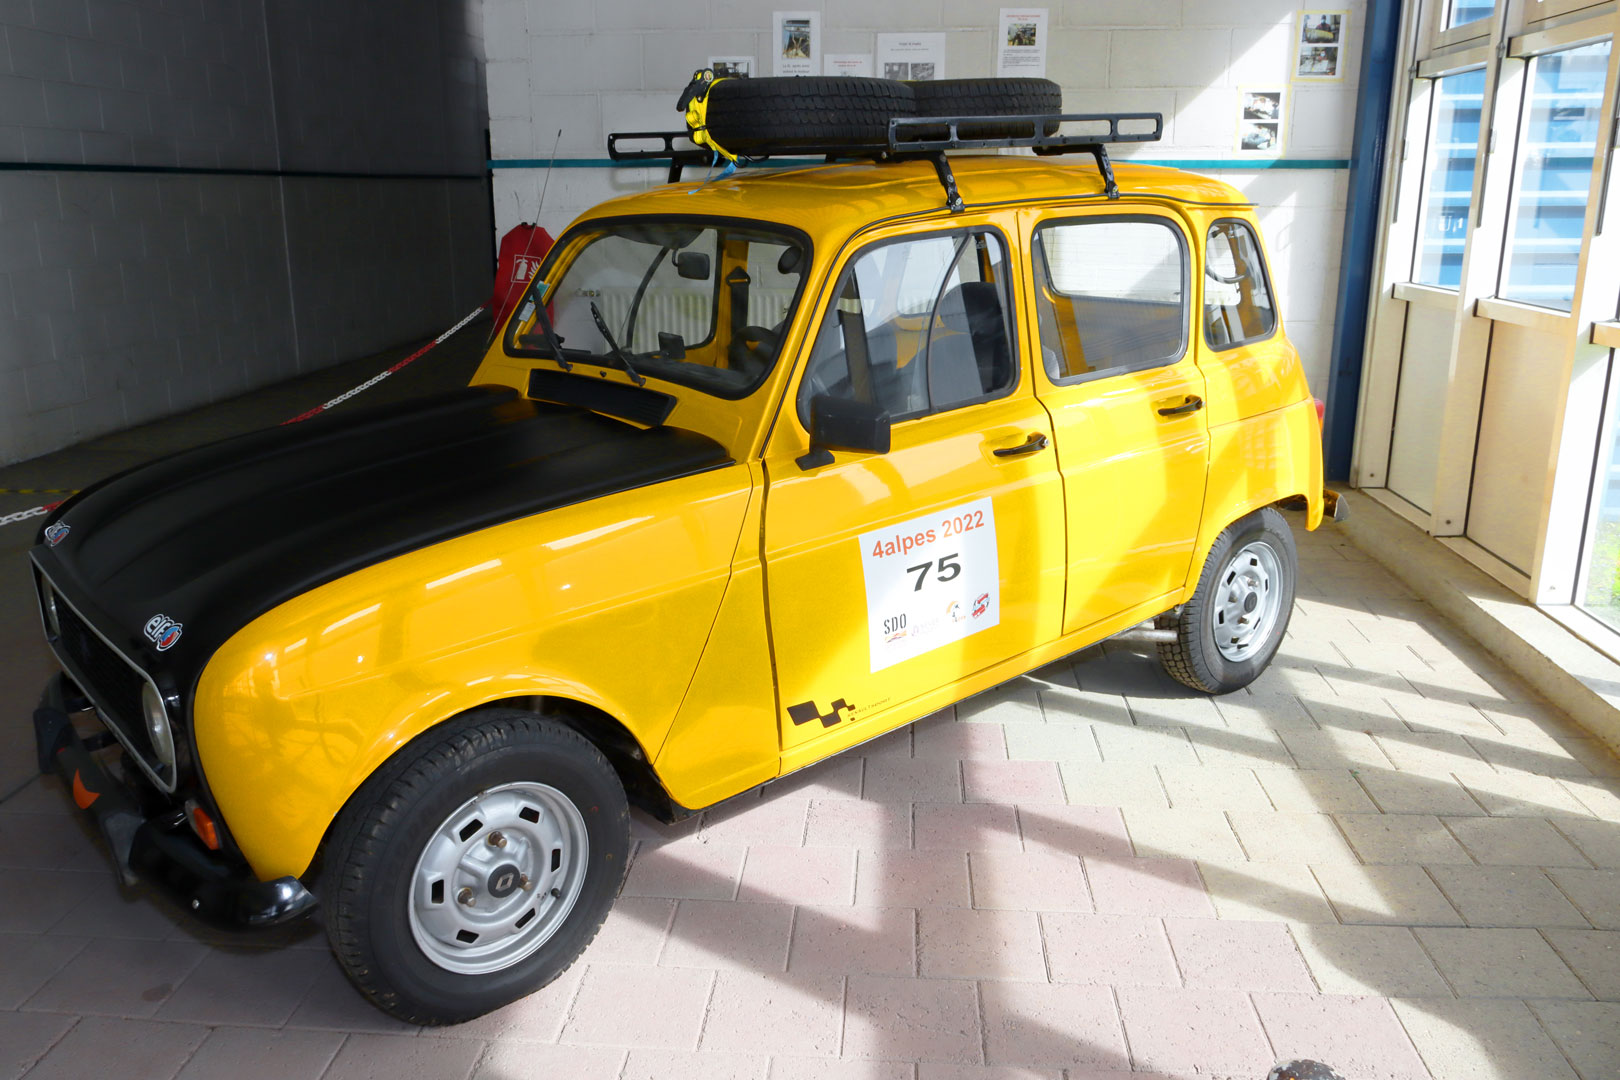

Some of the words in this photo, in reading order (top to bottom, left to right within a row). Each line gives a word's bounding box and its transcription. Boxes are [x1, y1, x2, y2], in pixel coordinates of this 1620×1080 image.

[872, 529, 936, 559] 4alpes
[941, 510, 985, 538] 2022
[906, 552, 961, 592] 75
[146, 616, 172, 639] elf
[883, 613, 907, 635] SDO
